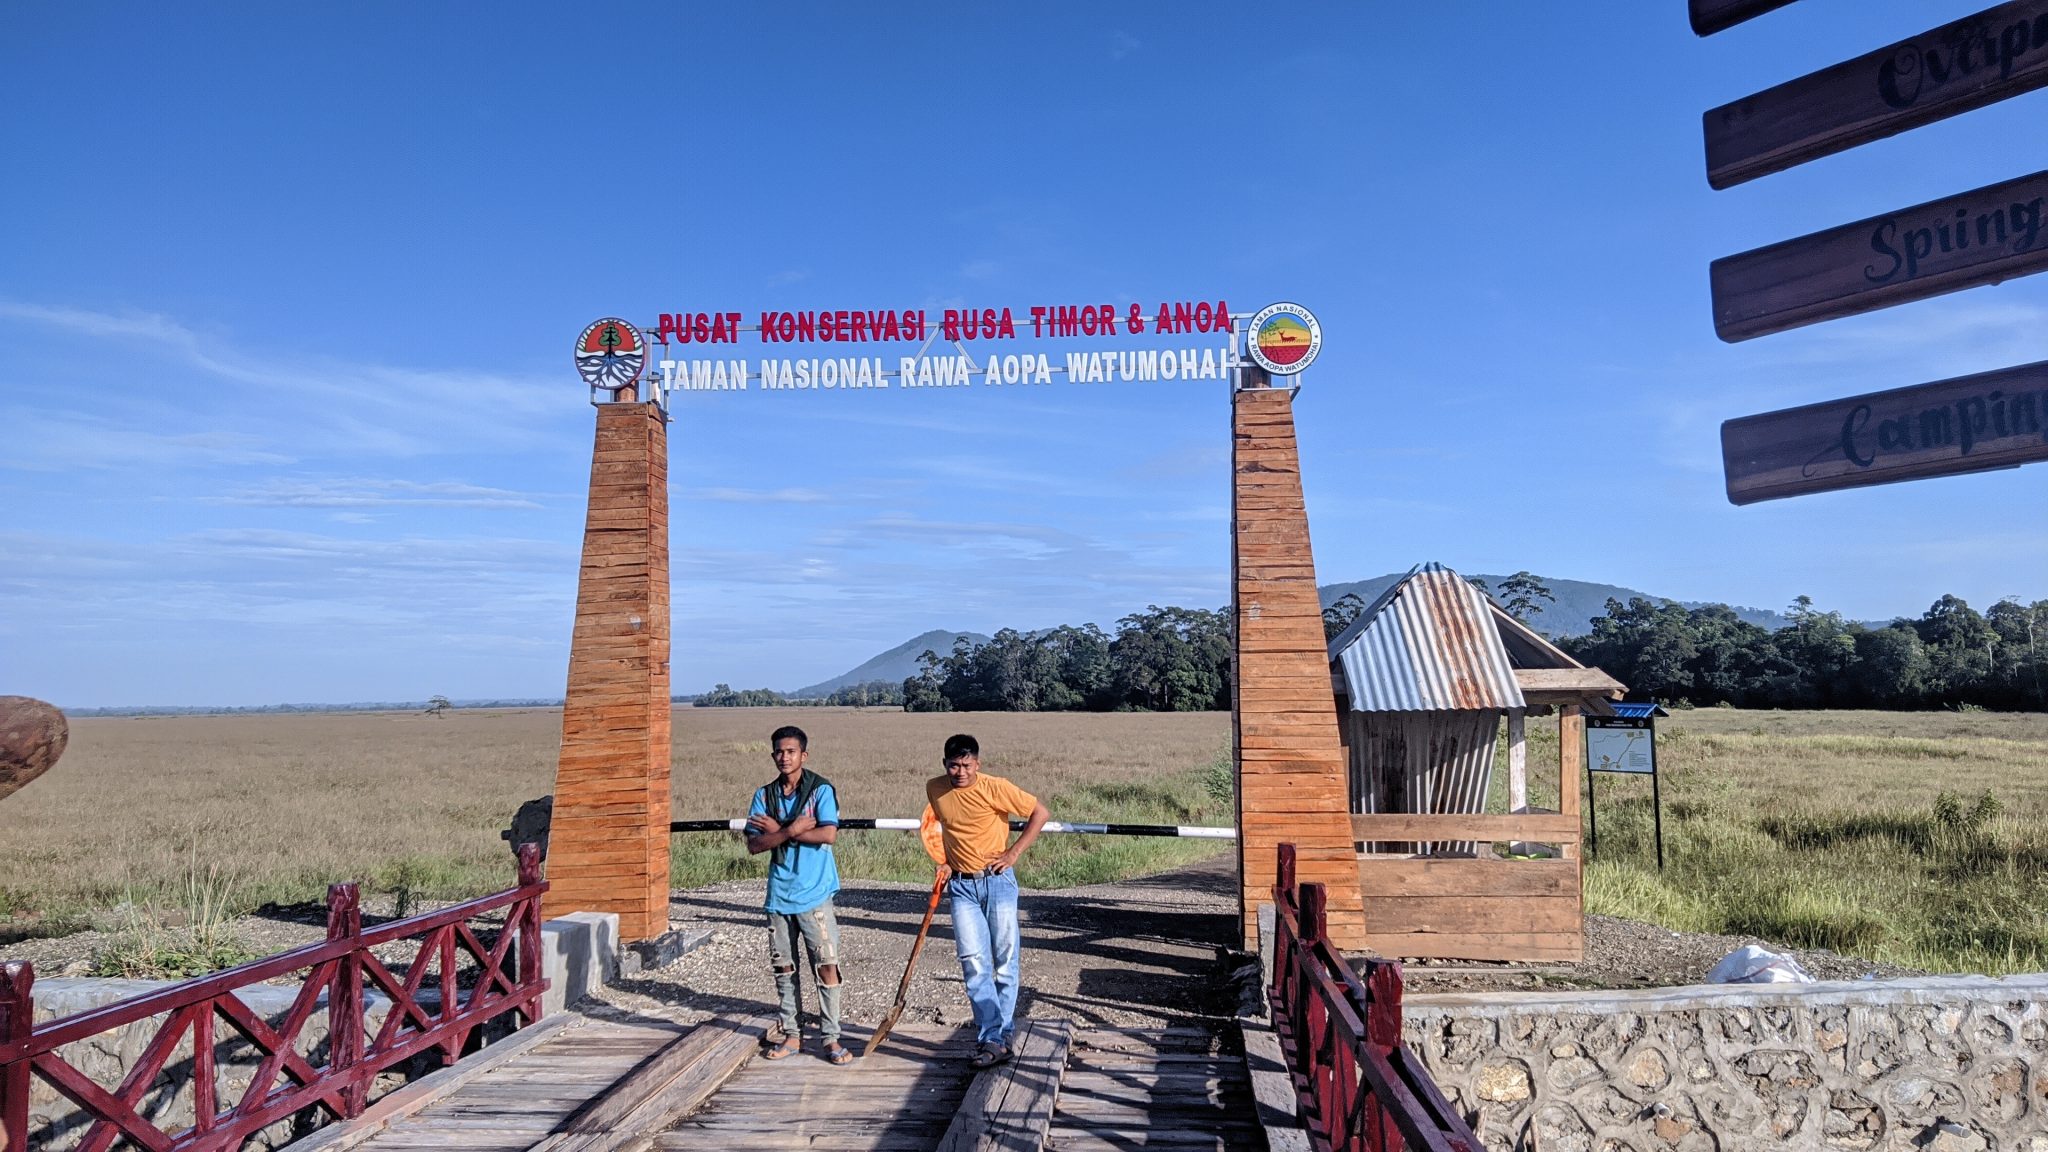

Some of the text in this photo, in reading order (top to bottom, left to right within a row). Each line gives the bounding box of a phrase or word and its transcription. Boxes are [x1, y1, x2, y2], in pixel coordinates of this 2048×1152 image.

[1864, 197, 2048, 282] Spring
[658, 300, 1235, 344] PUSAT KONSERVASI RUSA TIMOR & ANOA
[1252, 305, 1316, 332] TAMAN NASIONAL
[660, 348, 1227, 391] TAMAN NASIONAL RAWA AOPA WATUMOHAI
[1251, 342, 1319, 372] RAWA AOPA WATUMOHAI
[1803, 390, 2048, 478] Campin
